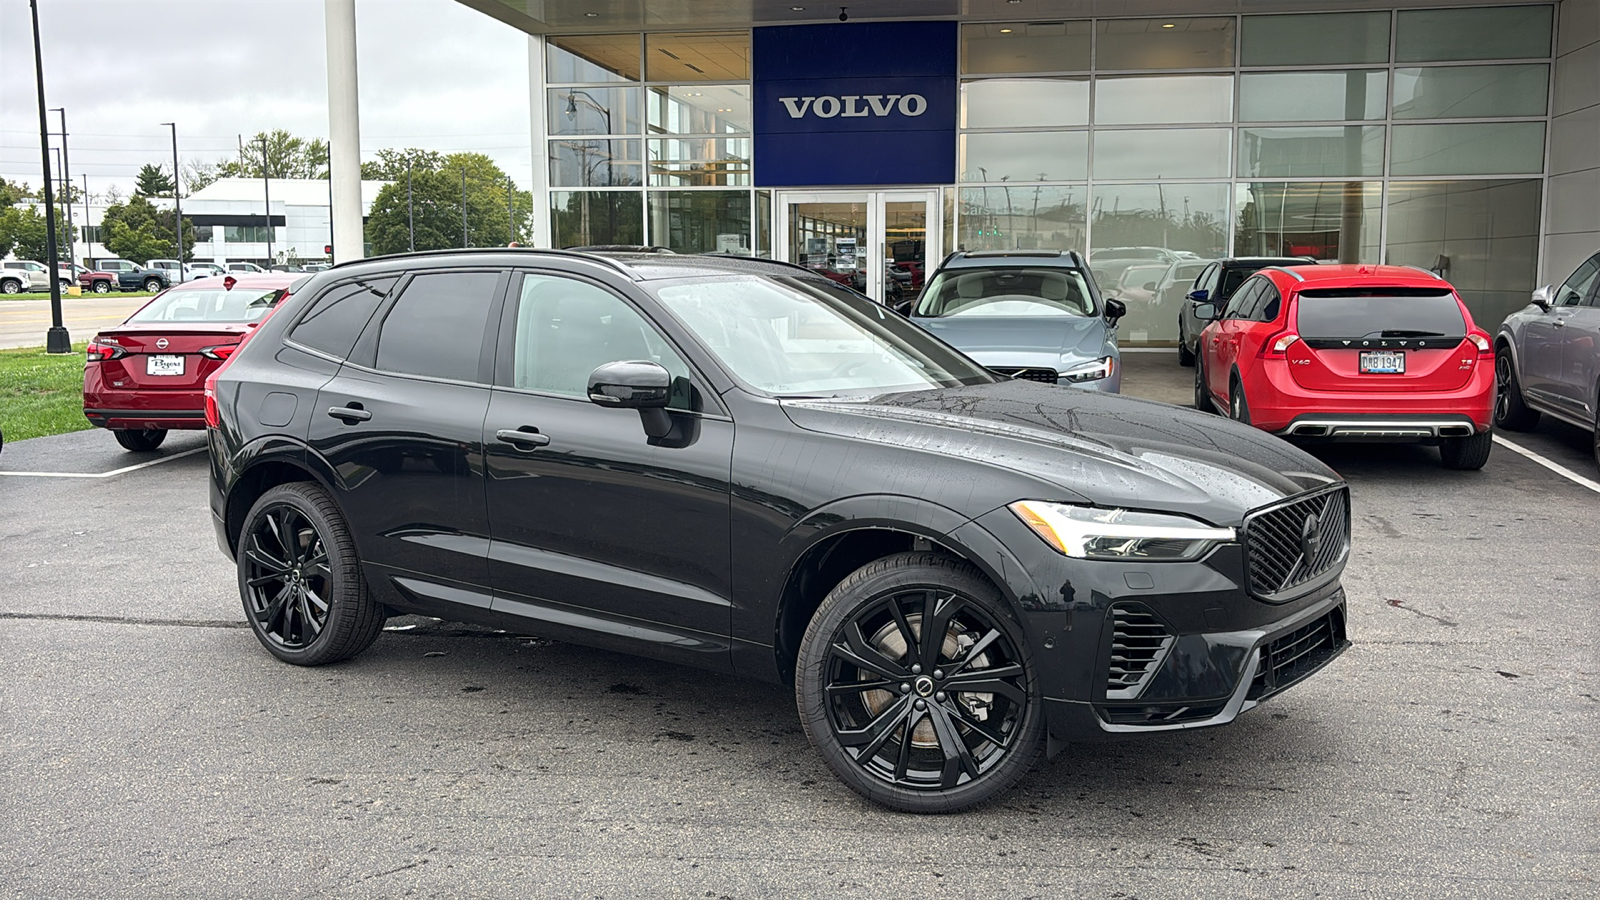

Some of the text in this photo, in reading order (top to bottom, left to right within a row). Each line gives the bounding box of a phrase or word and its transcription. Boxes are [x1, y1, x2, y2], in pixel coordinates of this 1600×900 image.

[779, 94, 927, 118] VOLVO
[960, 204, 991, 215] Cars
[1381, 356, 1402, 369] 1947
